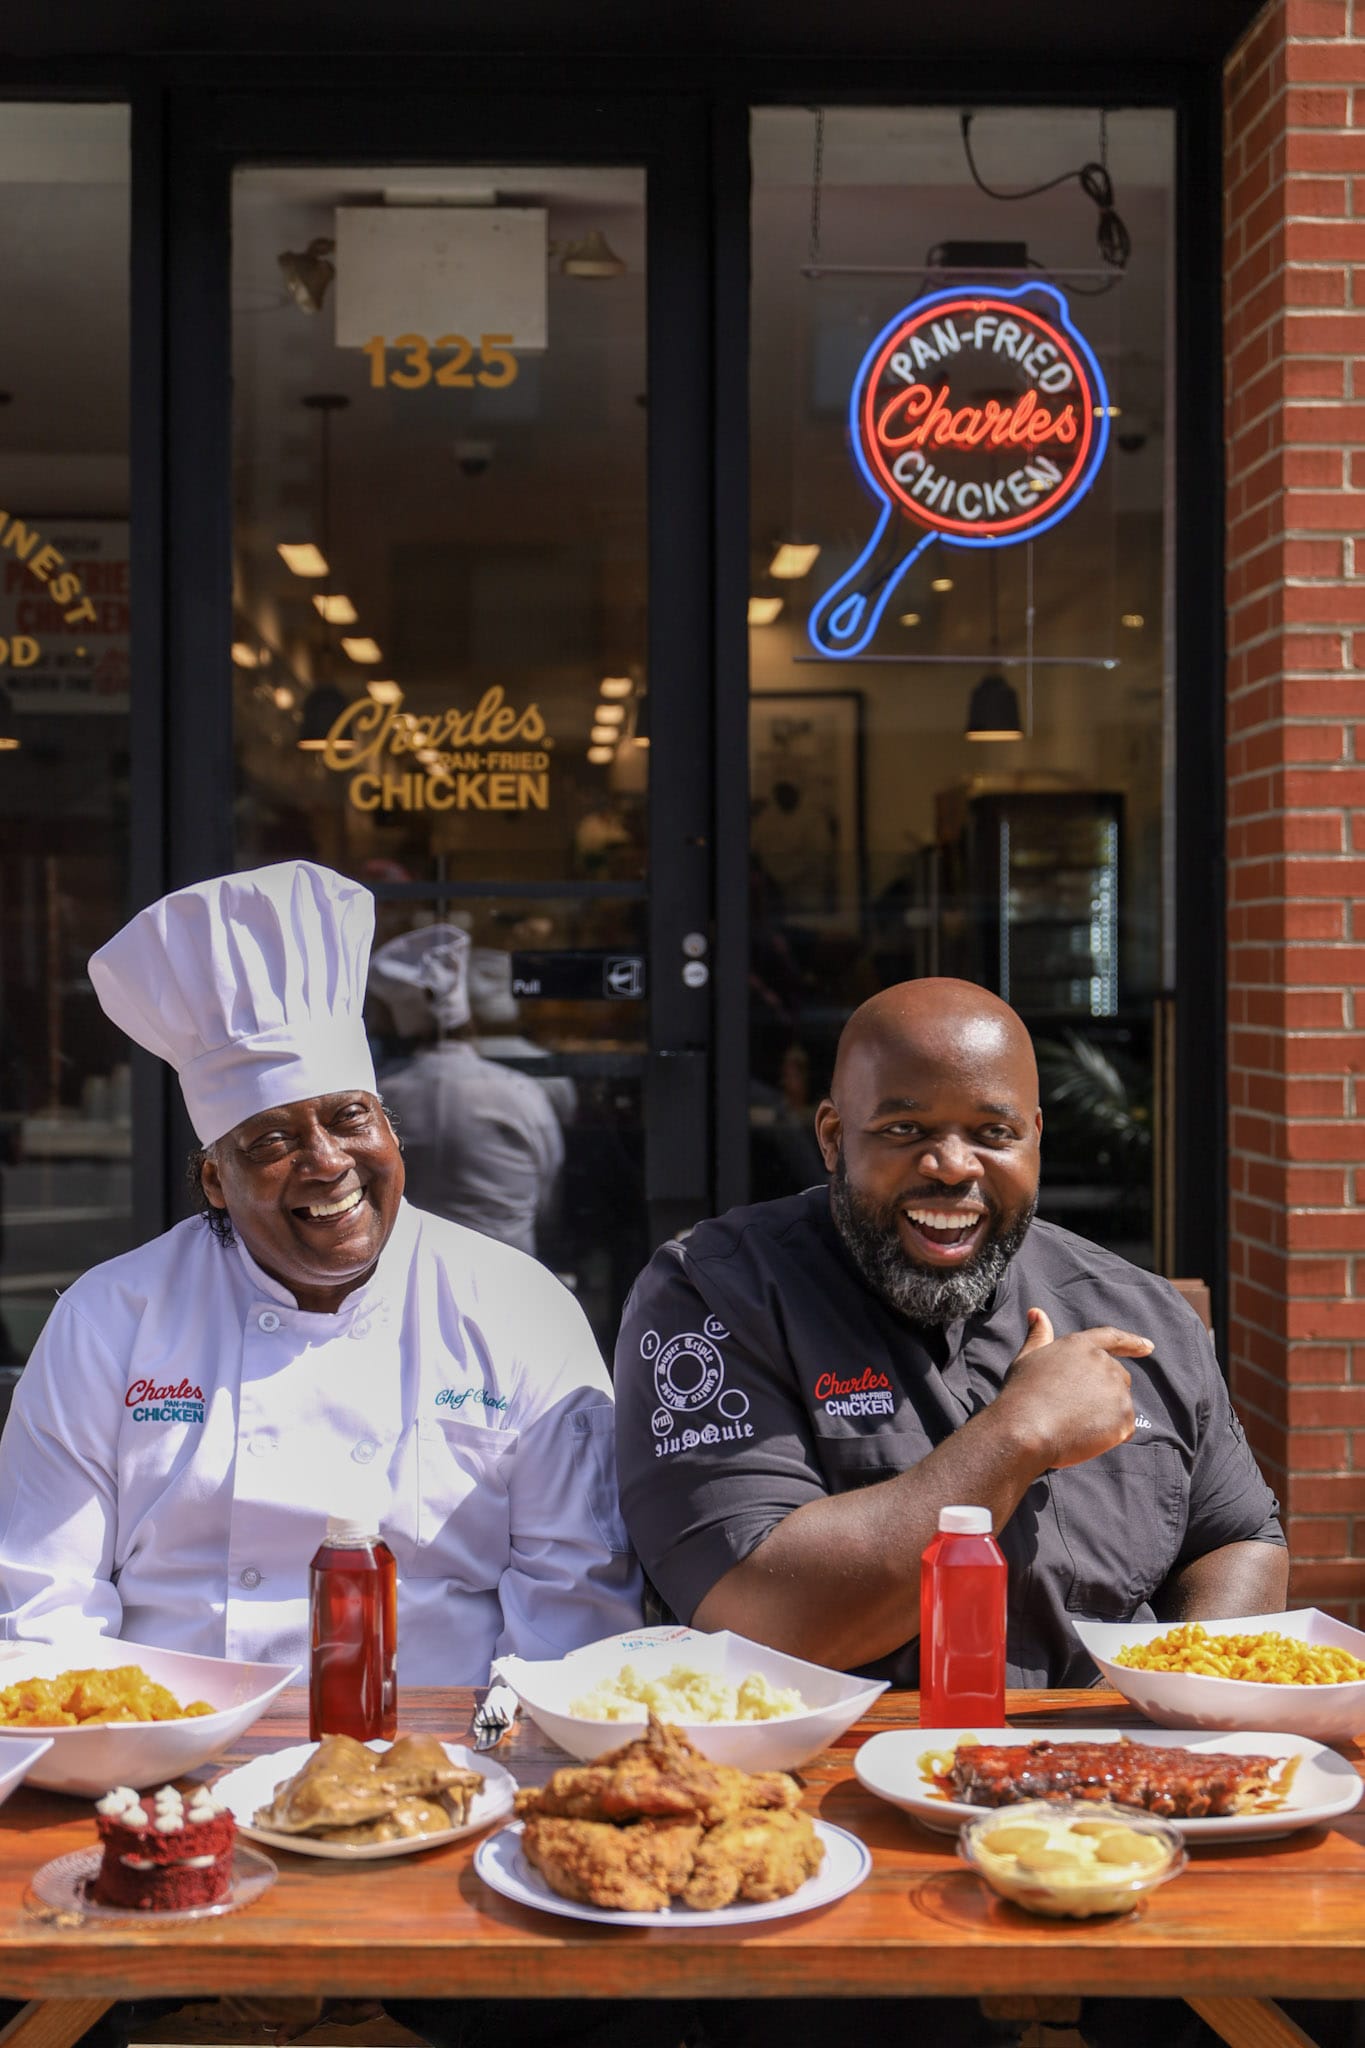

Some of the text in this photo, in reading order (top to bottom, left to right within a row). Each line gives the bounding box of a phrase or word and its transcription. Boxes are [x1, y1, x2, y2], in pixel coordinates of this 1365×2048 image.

[362, 333, 519, 389] 1325
[889, 316, 1073, 394] PAN-FRIED
[877, 383, 1078, 448] Charles
[892, 451, 1064, 520] CHICKEN
[350, 773, 549, 811] CHICKEN
[684, 1337, 715, 1363] Triple
[125, 1378, 204, 1407] Charles
[814, 1366, 889, 1400] Charles
[850, 1391, 892, 1402] PAN-FRIED
[164, 1399, 204, 1410] PAN-FRIED
[435, 1388, 474, 1410] Chef
[825, 1399, 895, 1416] CHICKEN
[132, 1407, 204, 1423] CHICKEN
